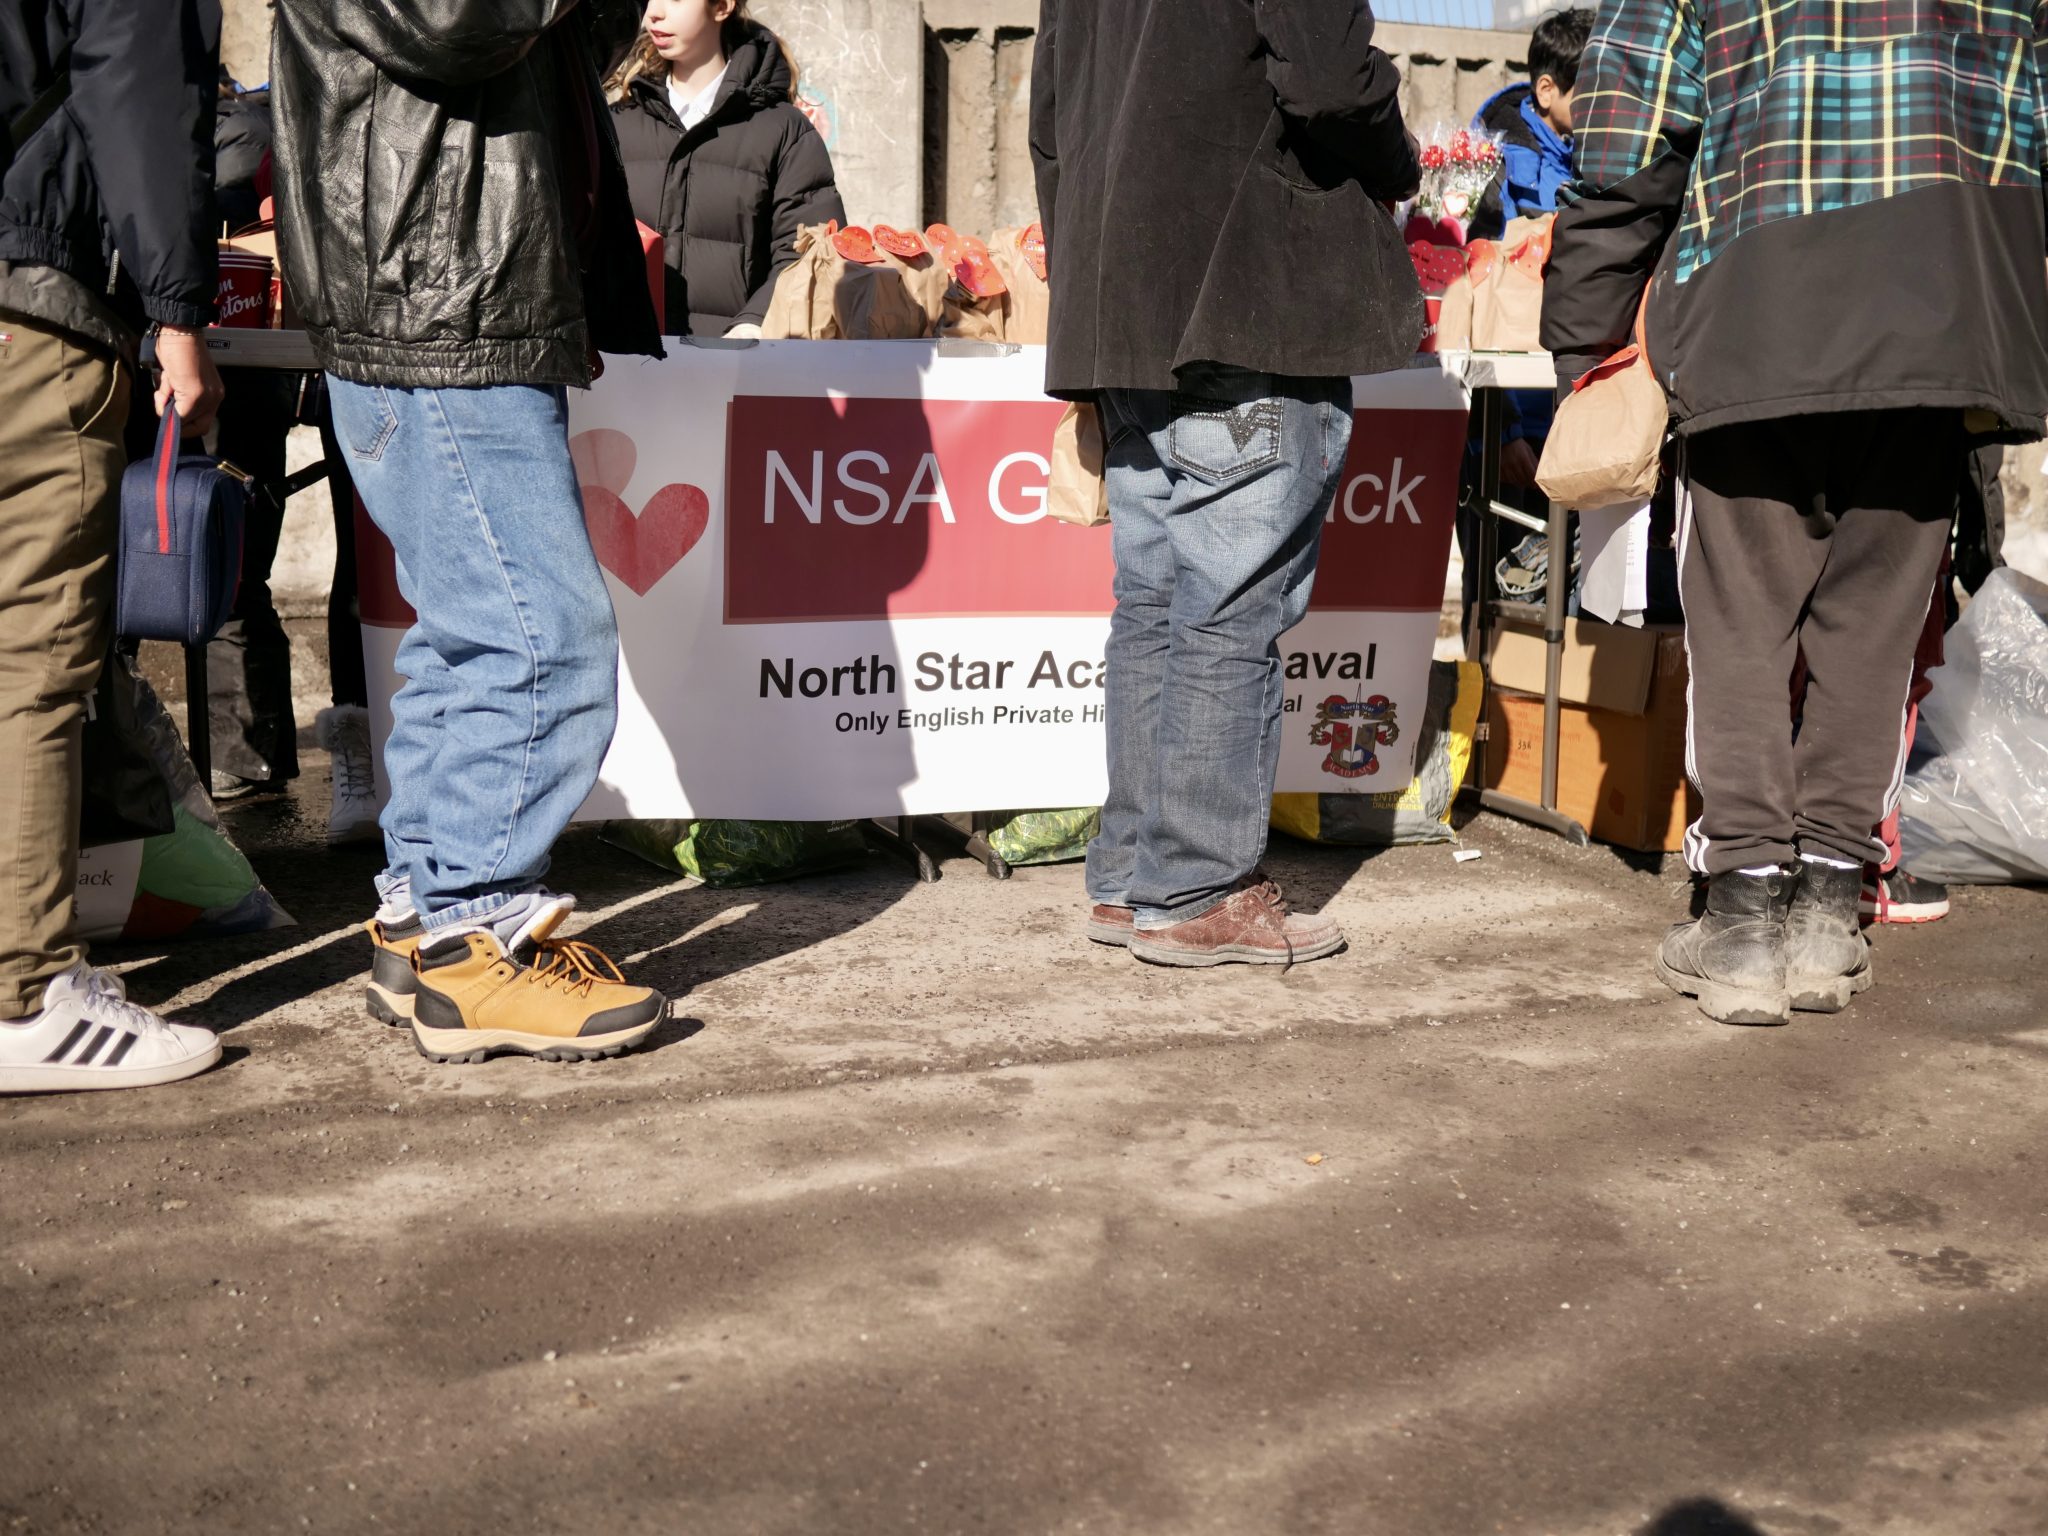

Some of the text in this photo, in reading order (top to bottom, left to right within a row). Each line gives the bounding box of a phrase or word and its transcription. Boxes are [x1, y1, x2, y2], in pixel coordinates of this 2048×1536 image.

[219, 292, 263, 321] rtons
[764, 450, 956, 526] NSA
[988, 451, 1051, 525] G
[759, 655, 896, 698] North
[913, 651, 1014, 692] Star
[1284, 643, 1377, 680] aval
[835, 694, 1302, 735] Only English Private Hi al
[78, 869, 114, 886] ack
